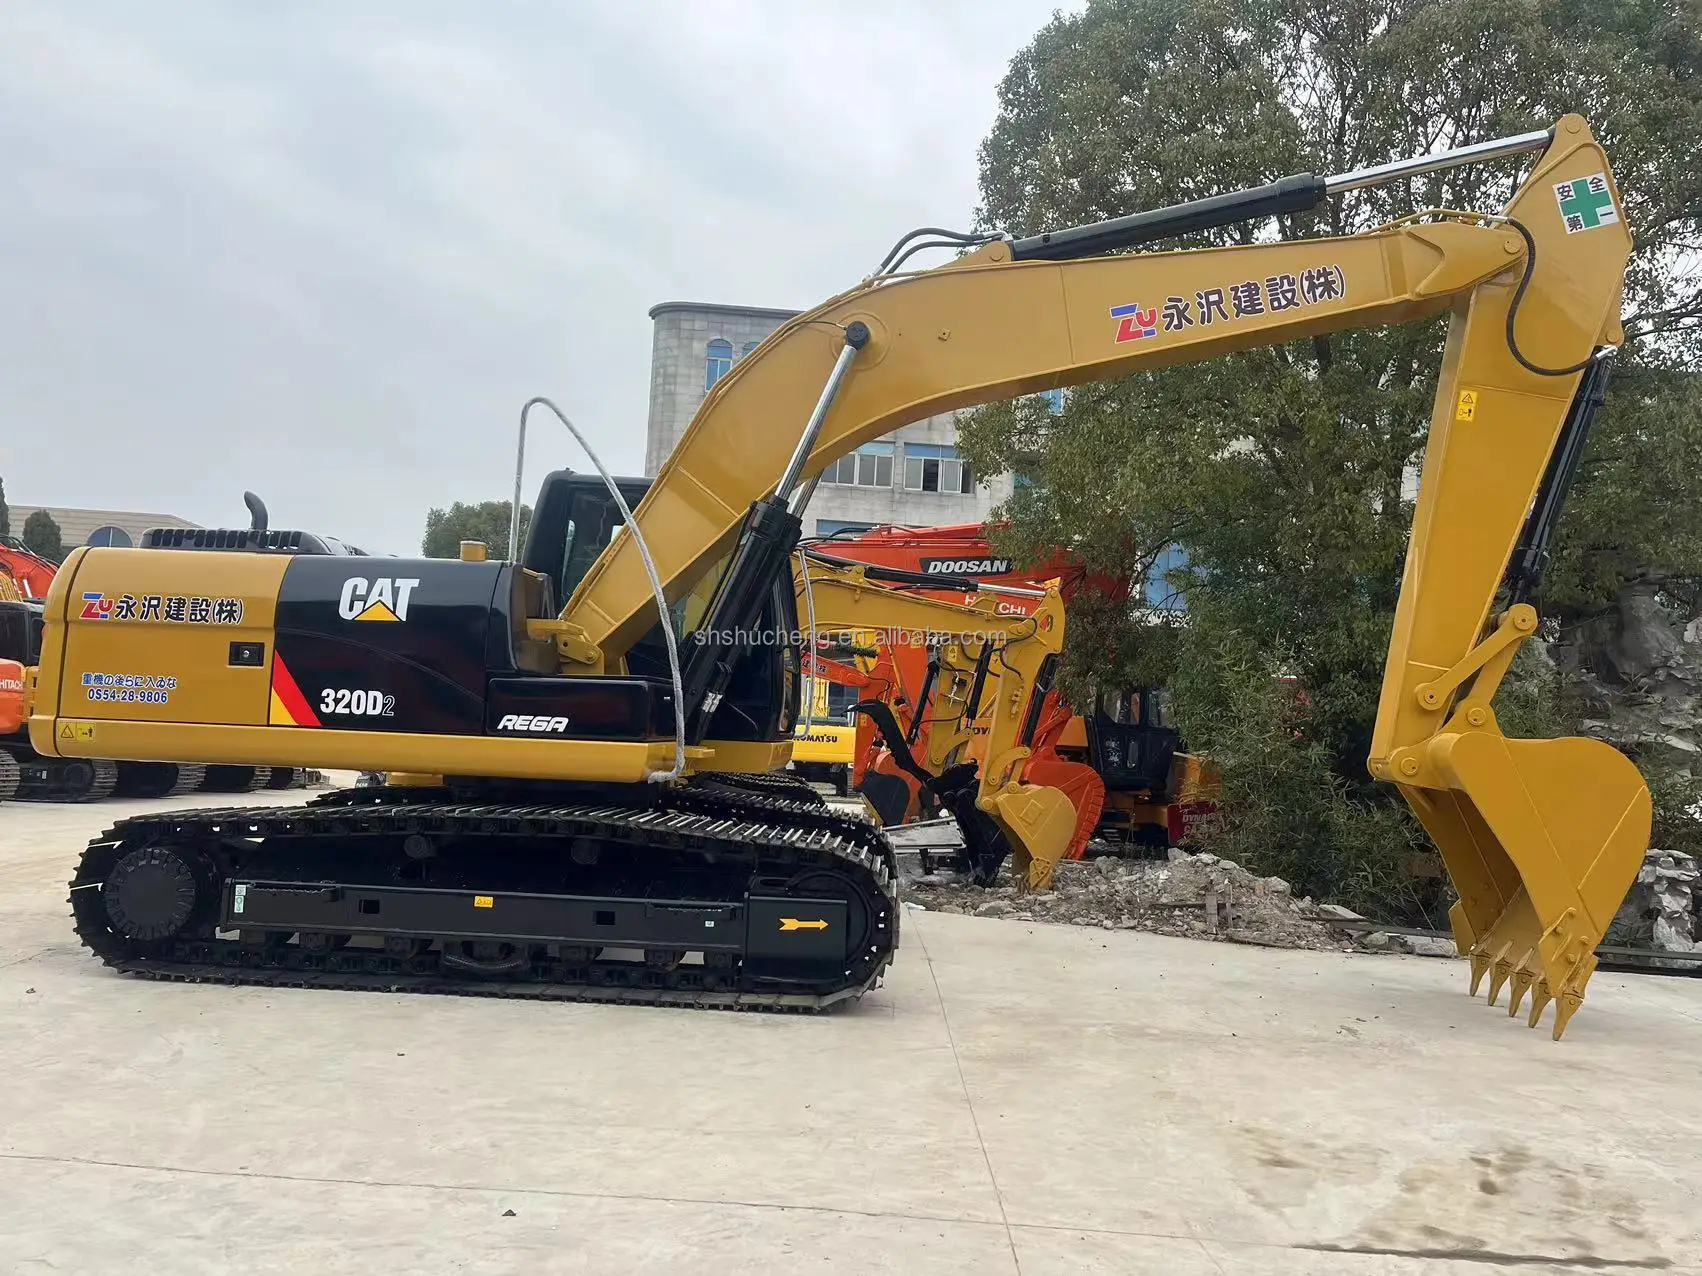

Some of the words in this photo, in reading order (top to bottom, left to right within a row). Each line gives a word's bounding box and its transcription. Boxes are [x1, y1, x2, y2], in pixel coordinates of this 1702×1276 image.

[928, 560, 1008, 574] DOOSAN
[338, 577, 420, 622] CAT
[320, 688, 395, 717] 320D2
[497, 714, 569, 733] REGA
